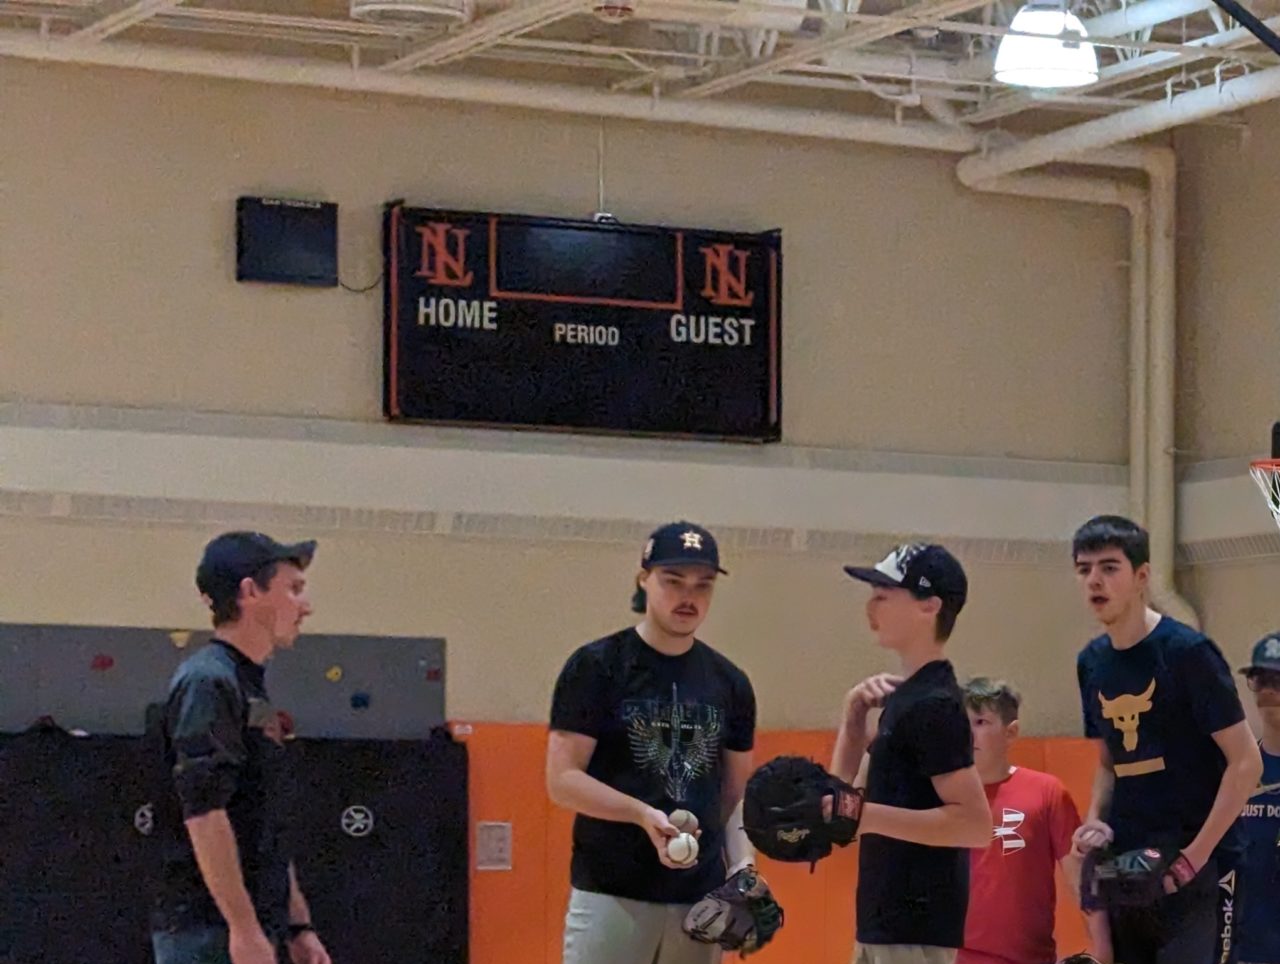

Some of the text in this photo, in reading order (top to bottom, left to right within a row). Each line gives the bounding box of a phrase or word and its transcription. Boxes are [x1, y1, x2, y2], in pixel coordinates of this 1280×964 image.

[418, 297, 498, 330] HOME
[554, 323, 620, 346] PERIOD
[670, 314, 755, 346] GUEST
[1241, 803, 1265, 817] JUST
